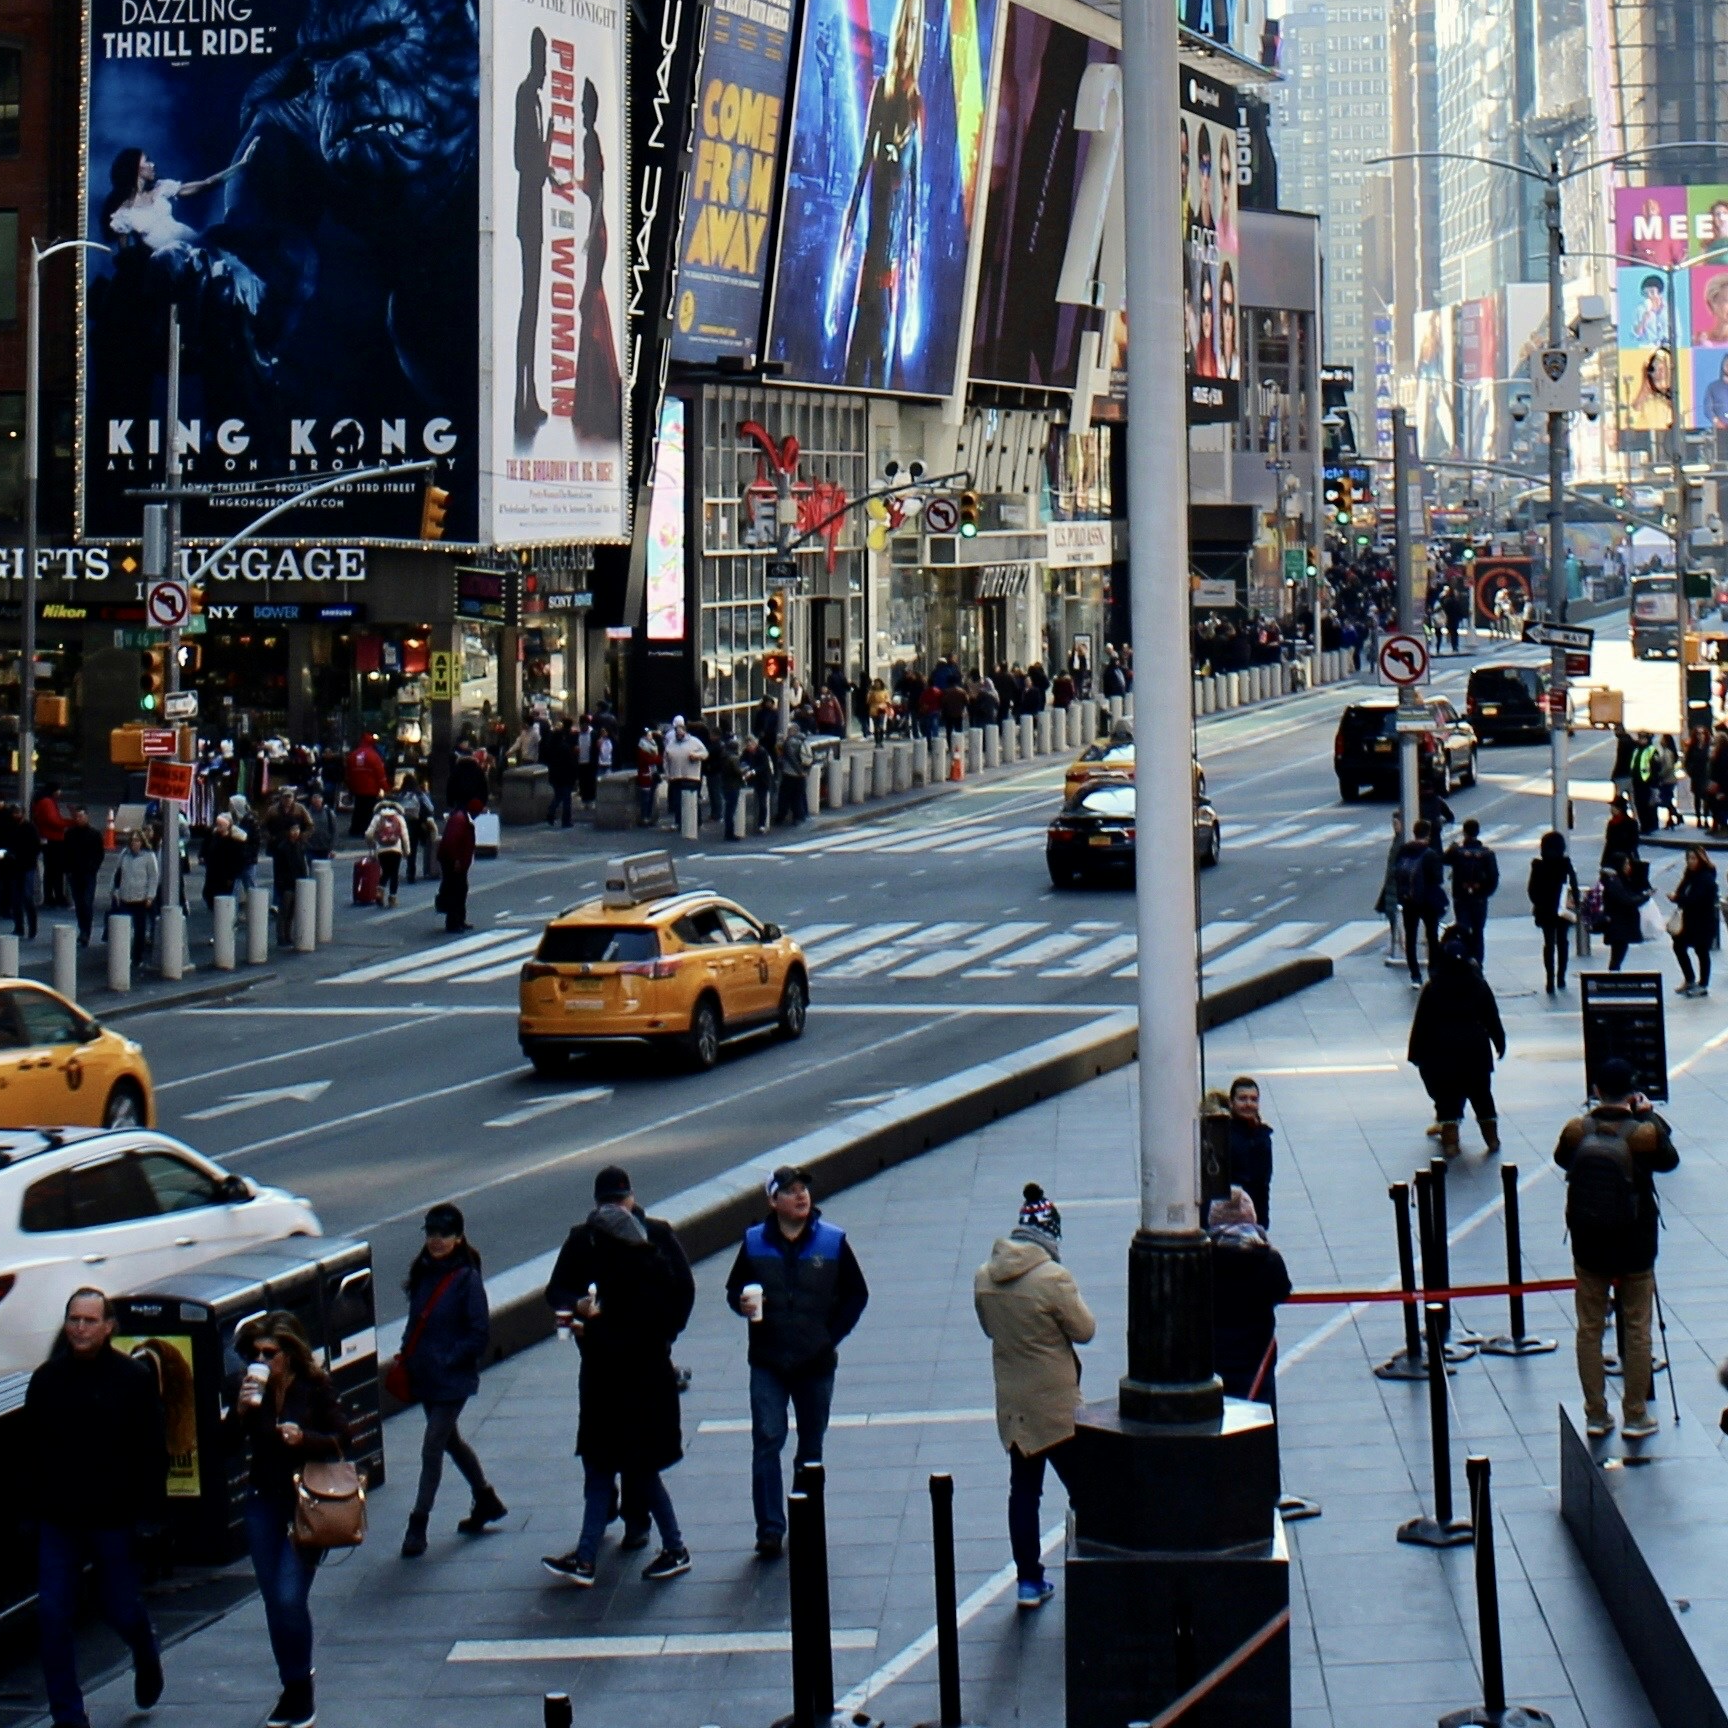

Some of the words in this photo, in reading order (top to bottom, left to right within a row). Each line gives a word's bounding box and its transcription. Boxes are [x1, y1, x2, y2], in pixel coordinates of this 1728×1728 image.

[103, 30, 191, 59] THRILL
[550, 39, 576, 204] PRETTY
[703, 78, 781, 153] COME
[1237, 106, 1253, 186] 1500
[693, 139, 773, 213] FROM
[684, 204, 768, 274] AWAY
[551, 238, 575, 419] WOMAN
[108, 418, 250, 455] KING
[291, 417, 457, 456] KONG
[107, 458, 194, 471] ALIE
[225, 458, 258, 471] ON
[519, 460, 531, 481] BIG
[533, 460, 567, 482] BROADWAY
[333, 483, 353, 493] AND
[383, 482, 415, 493] STREET
[179, 548, 366, 581] UGGAGE
[42, 604, 87, 619] Nikon
[208, 604, 238, 619] NY
[254, 606, 300, 619] BOWER
[321, 608, 353, 618] SAMSUNG
[435, 654, 447, 693] ATM
